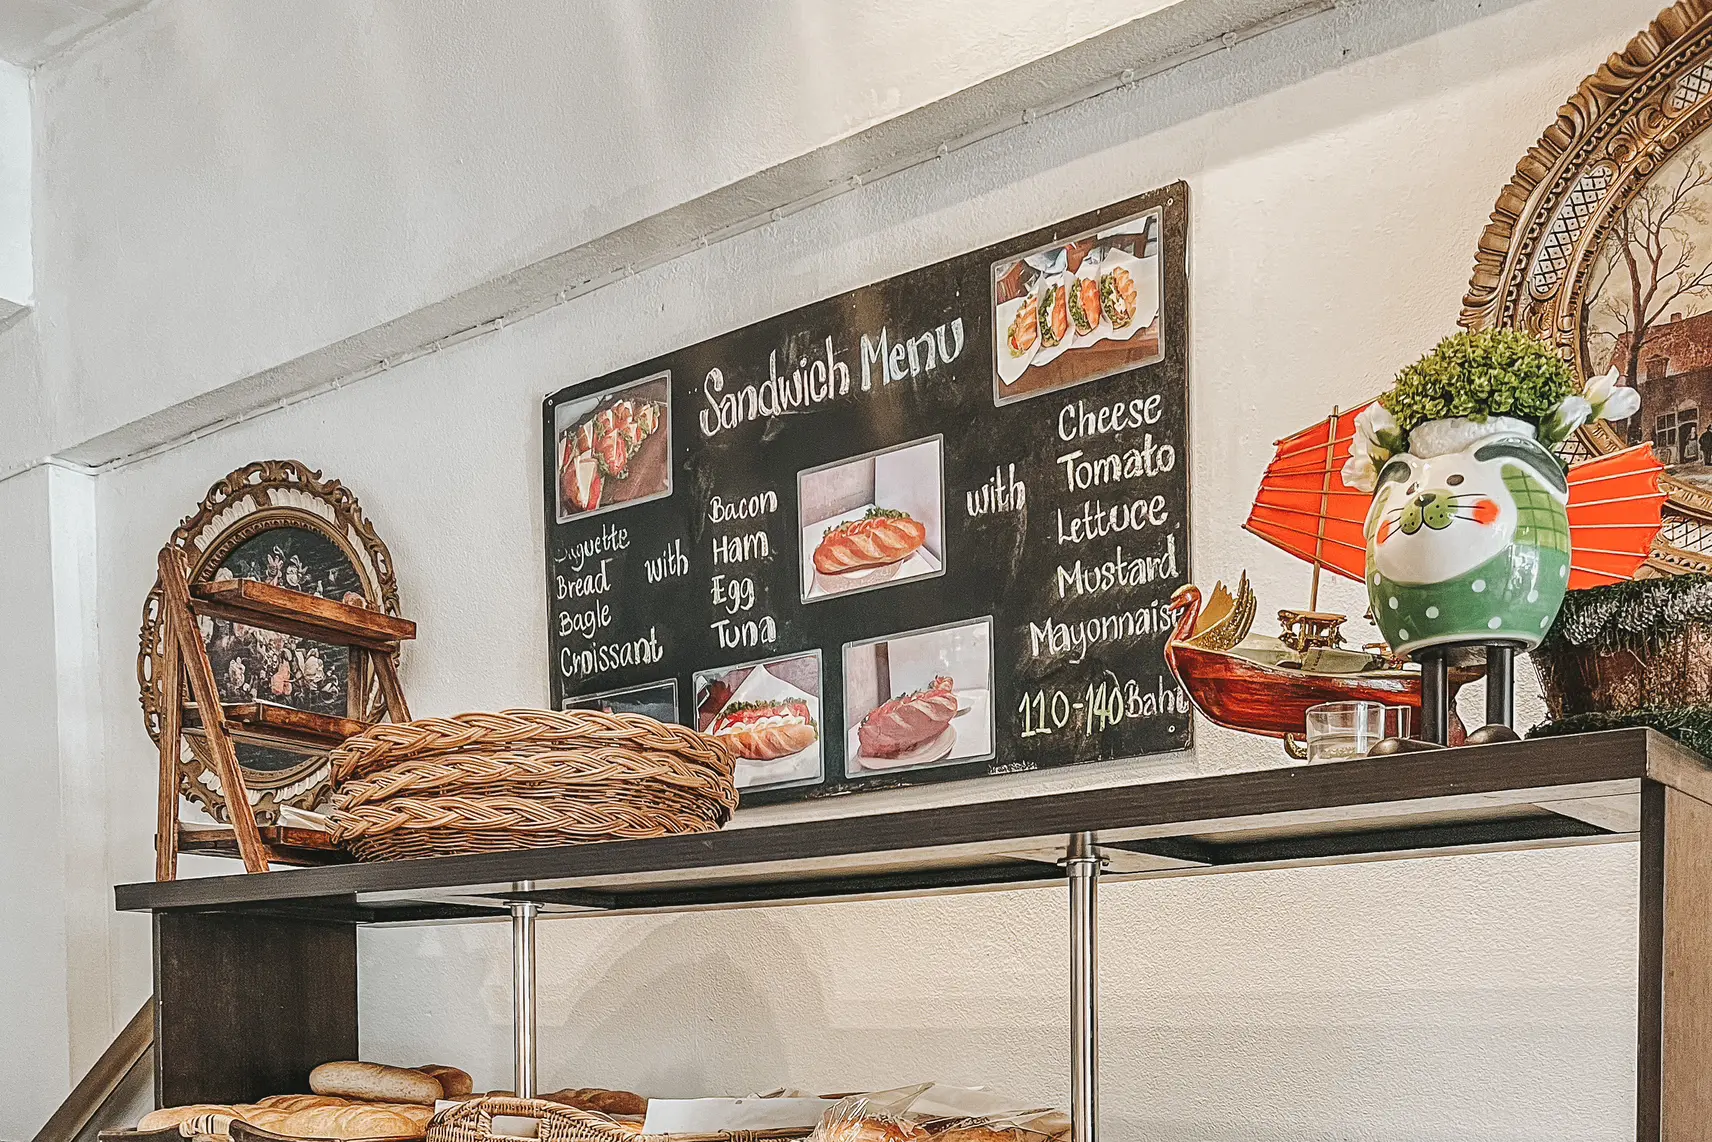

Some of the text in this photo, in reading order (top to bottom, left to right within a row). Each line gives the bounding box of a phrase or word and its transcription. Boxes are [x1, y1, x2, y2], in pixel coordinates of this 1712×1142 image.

[699, 317, 965, 437] Sandwich Menu
[1057, 393, 1162, 442] Cheese
[1056, 433, 1176, 493] Tomato
[708, 490, 779, 524] Bacon
[966, 462, 1027, 518] with
[1056, 494, 1169, 546] Lettuce
[553, 523, 631, 572] guette
[643, 538, 690, 584] with
[711, 529, 770, 566] Ham
[1056, 532, 1181, 599] Mustard
[556, 560, 612, 600] Bread
[709, 574, 756, 614] Egg
[558, 601, 612, 638] Bagle
[709, 615, 778, 649] Tuna
[560, 626, 664, 678] Croissant
